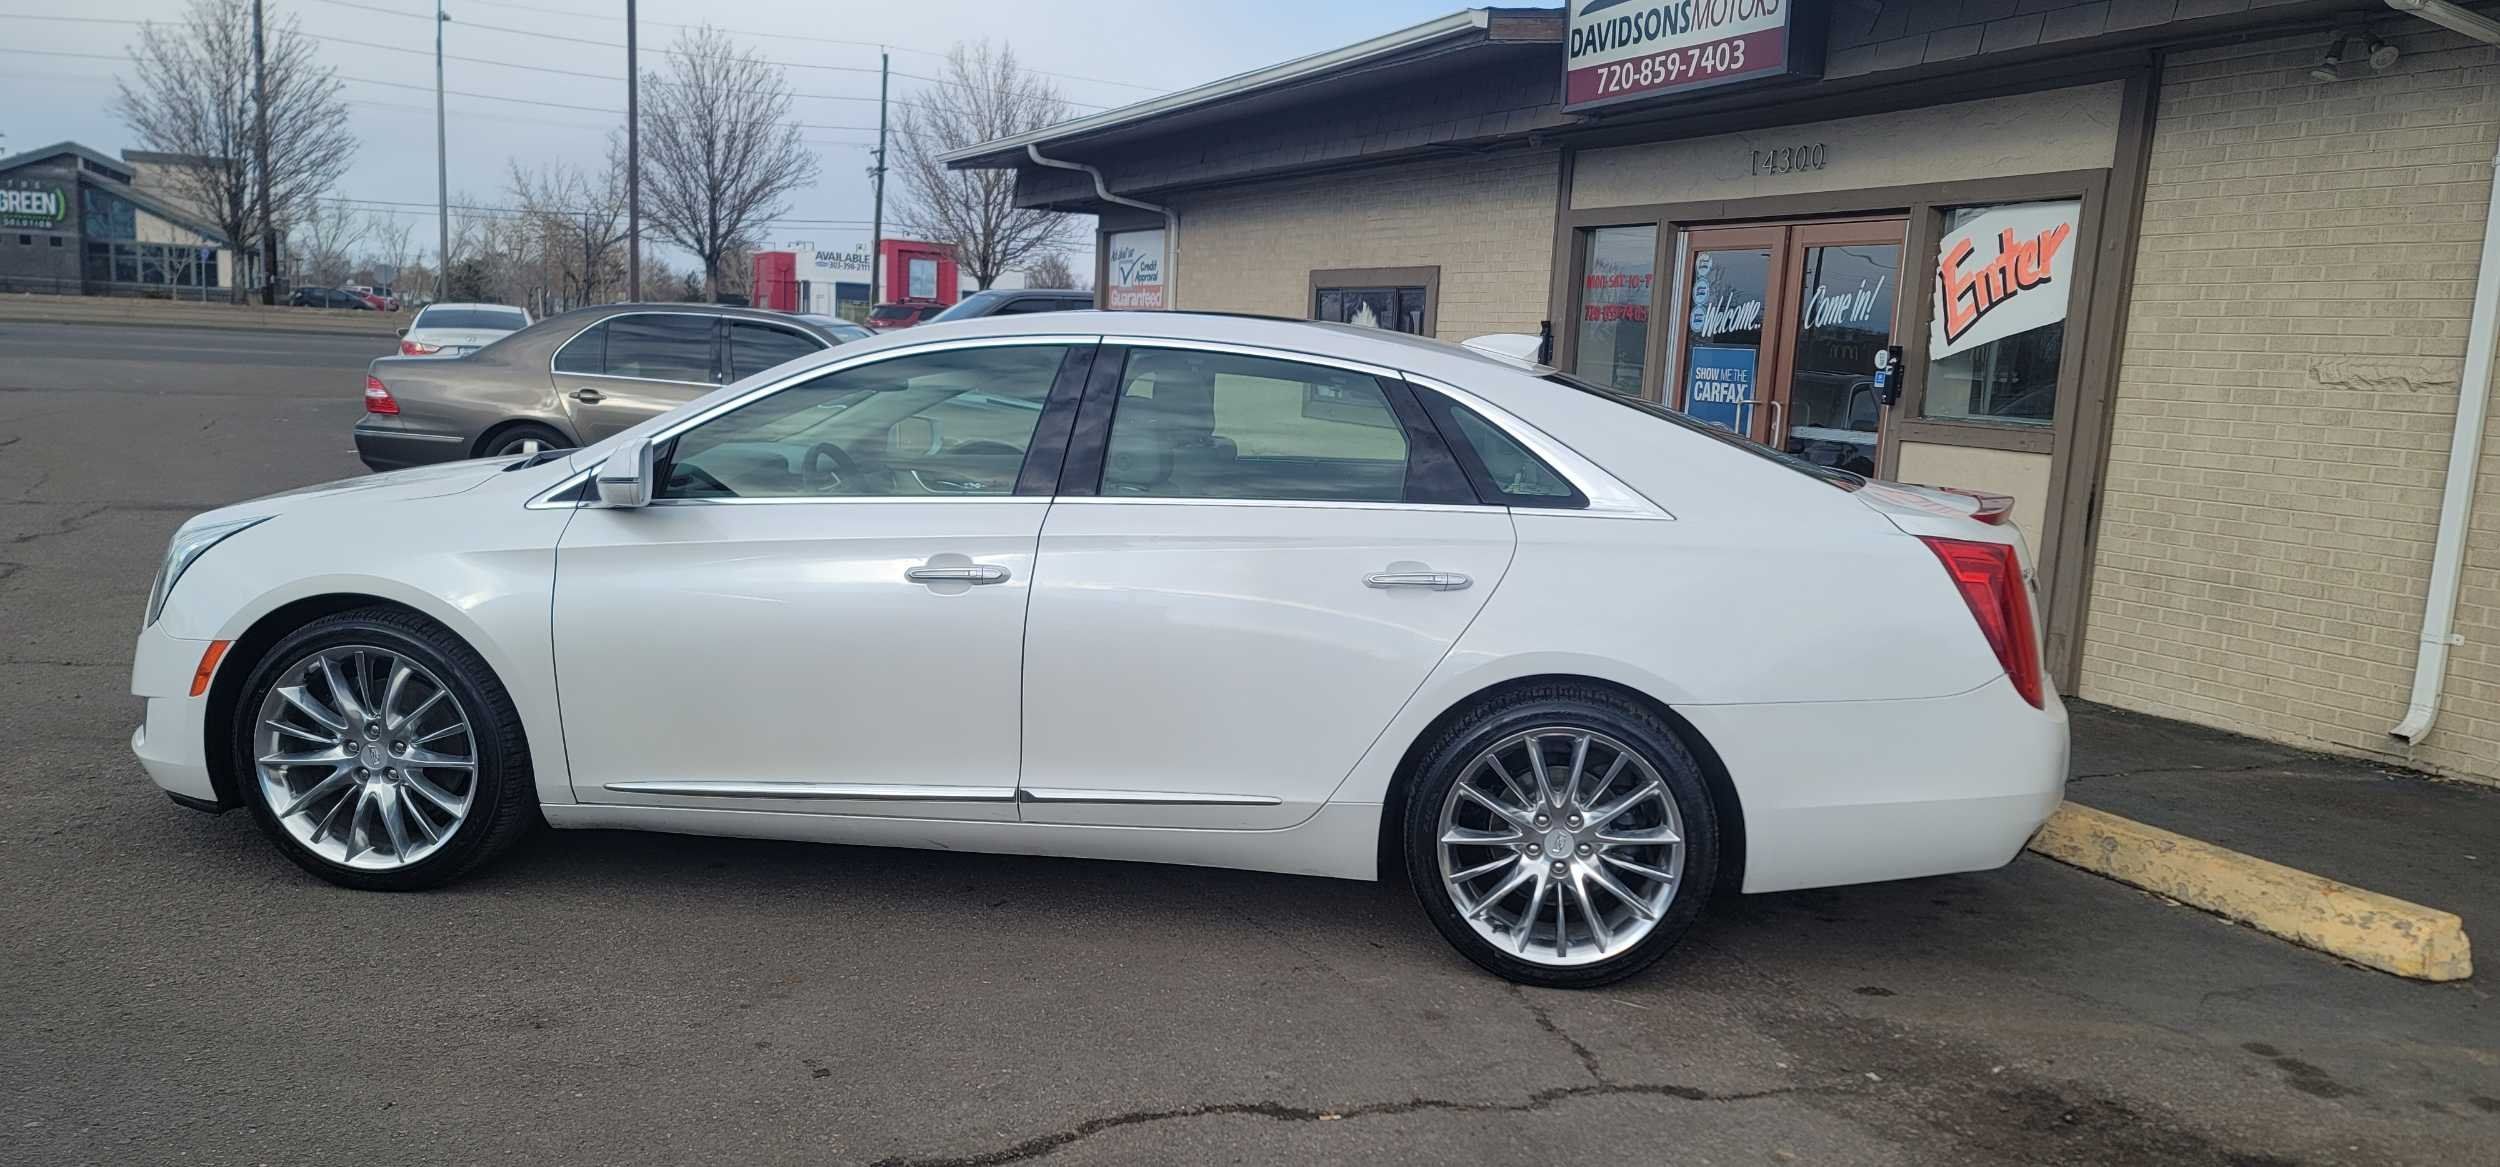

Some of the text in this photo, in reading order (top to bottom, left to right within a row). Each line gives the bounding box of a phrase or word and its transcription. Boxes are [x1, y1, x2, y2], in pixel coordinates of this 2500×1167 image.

[1597, 39, 1746, 95] 720-859-7403
[1751, 142, 1826, 176] 14300
[0, 190, 56, 215] GREEN
[815, 251, 871, 264] AVAILABLE
[1141, 260, 1158, 271] Credit
[1939, 222, 2071, 346] Enter
[1804, 275, 1885, 329] Come in!
[1695, 367, 1719, 380] SHOW
[1694, 381, 1745, 404] CARFAX
